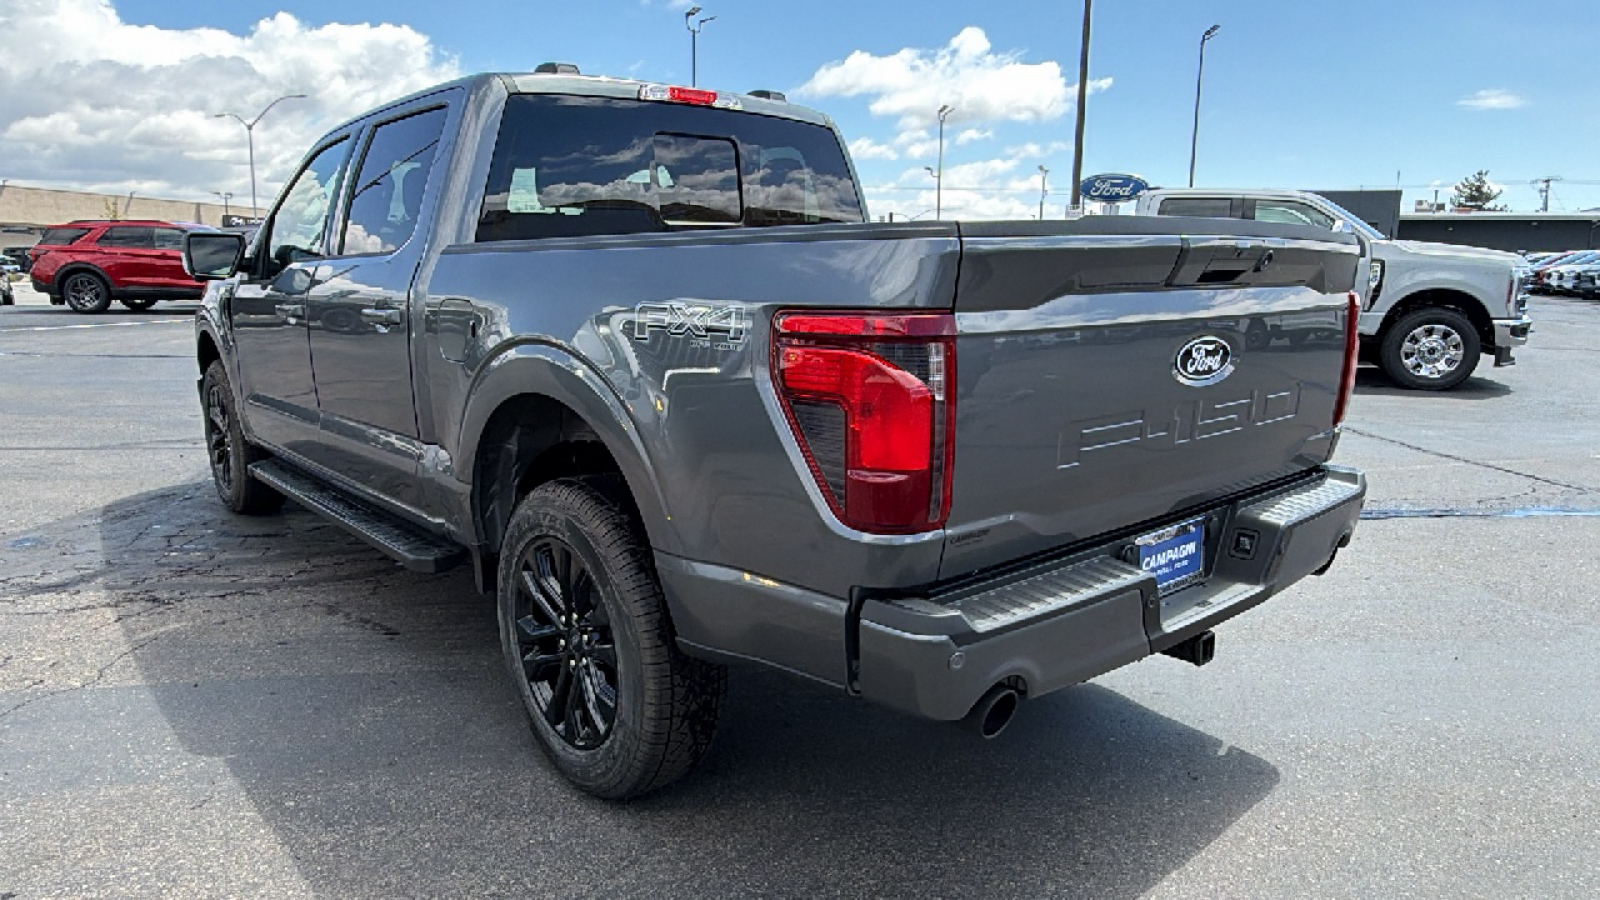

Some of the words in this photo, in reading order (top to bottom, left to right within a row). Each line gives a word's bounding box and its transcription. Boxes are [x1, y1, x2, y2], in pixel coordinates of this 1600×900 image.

[1090, 180, 1135, 196] Ford
[635, 304, 746, 343] FX4
[1187, 343, 1223, 373] Ford
